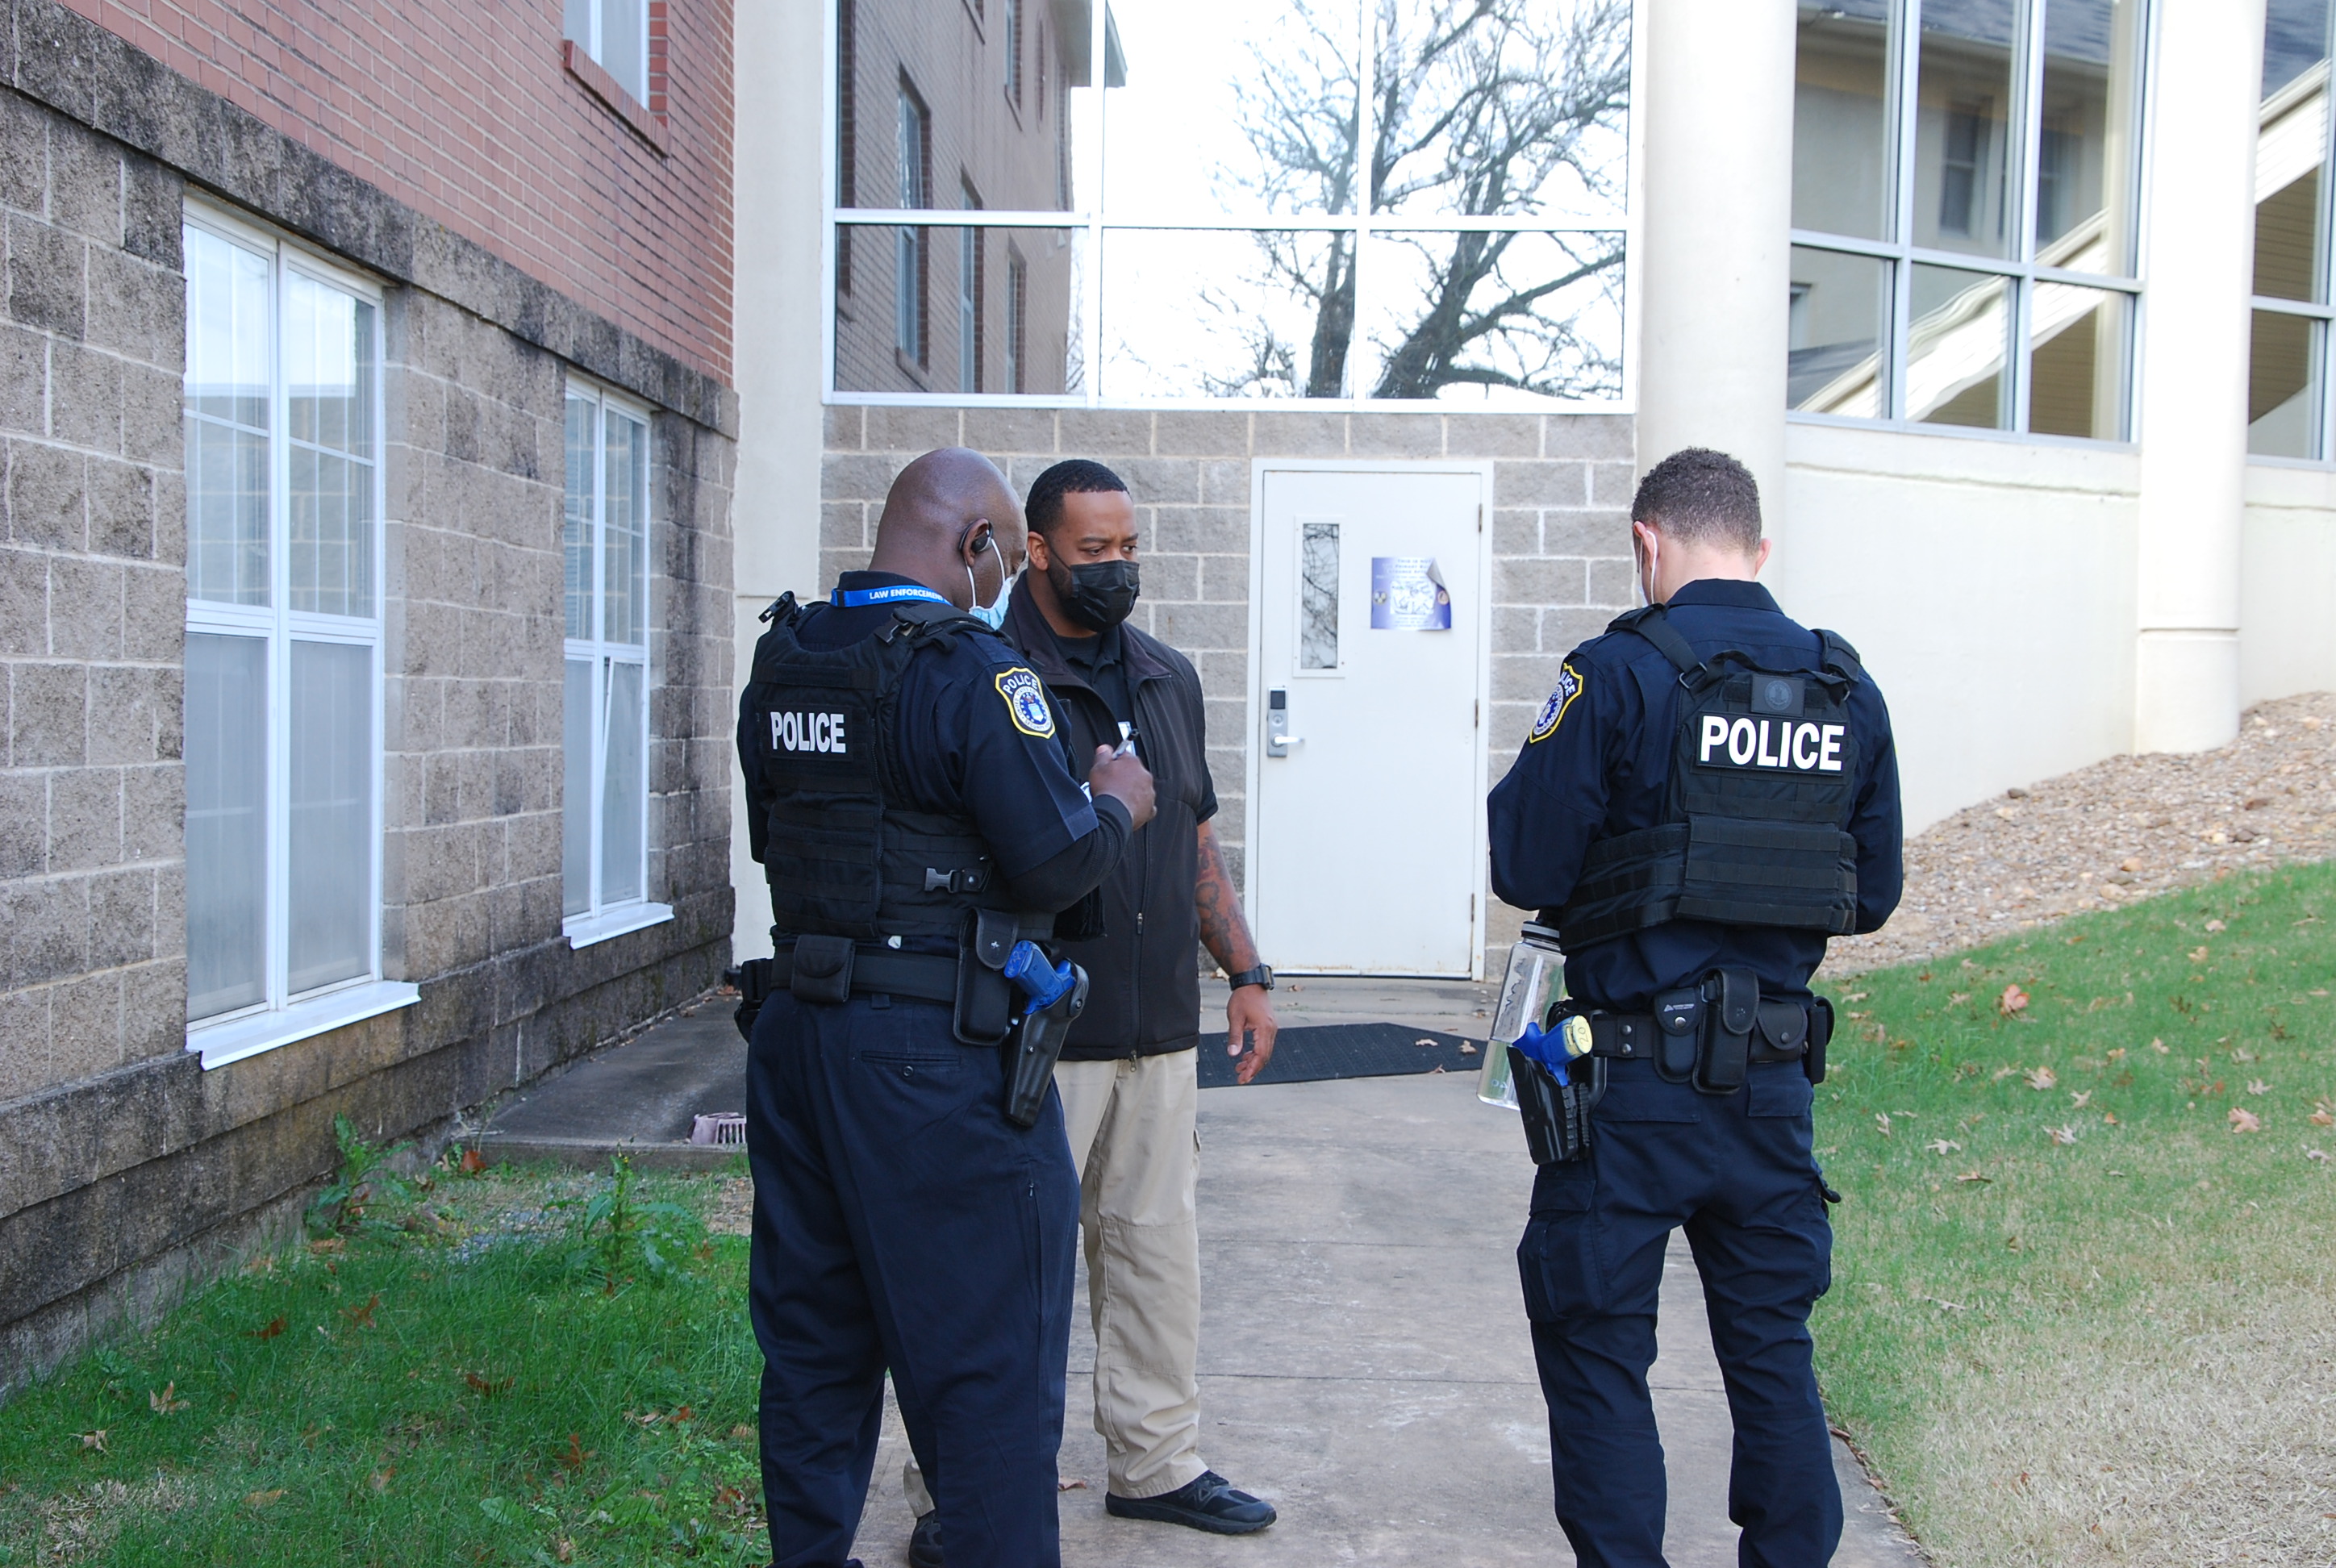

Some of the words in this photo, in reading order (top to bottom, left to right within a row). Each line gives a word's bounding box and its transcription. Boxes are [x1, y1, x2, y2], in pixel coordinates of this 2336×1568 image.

[869, 590, 890, 600] LAW
[891, 589, 944, 601] ENFORCEMENT
[1003, 674, 1038, 694] POLICE
[770, 711, 847, 754] POLICE
[1700, 715, 1846, 772] POLICE
